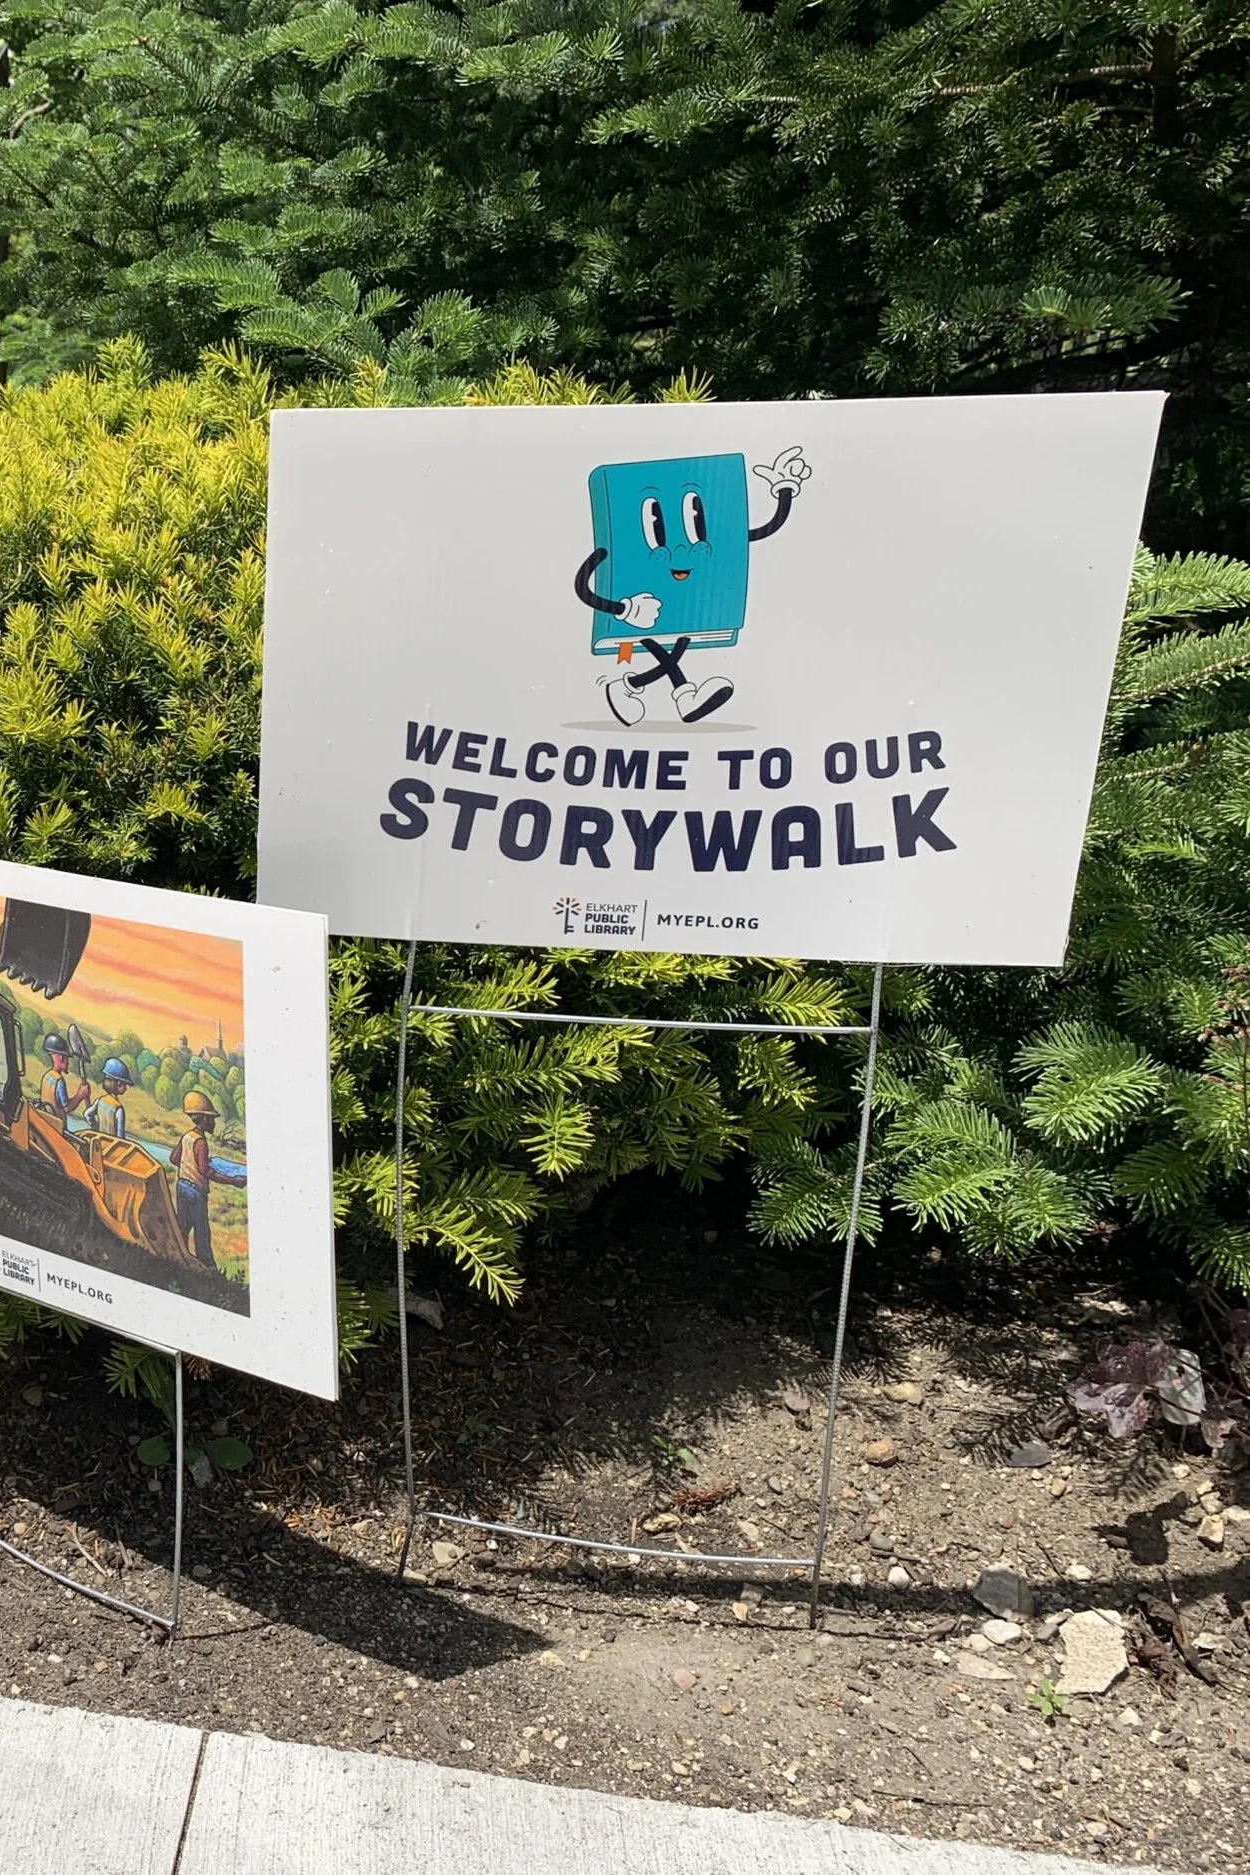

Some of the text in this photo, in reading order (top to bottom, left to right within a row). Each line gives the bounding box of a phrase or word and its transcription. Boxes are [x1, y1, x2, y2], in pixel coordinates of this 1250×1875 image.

[405, 720, 946, 790] WELCOME TO OUR
[379, 777, 957, 872] STORYWALK
[586, 903, 638, 914] ELKHART
[585, 913, 629, 924] PUBLIC
[657, 913, 760, 930] MYEPL.ORG
[584, 925, 636, 935] LIBRARY
[2, 1251, 35, 1266] ELKHART
[2, 1259, 30, 1275] PUBLIC
[3, 1268, 35, 1286] LIBRARY
[46, 1272, 113, 1304] MYEPL.ORG
